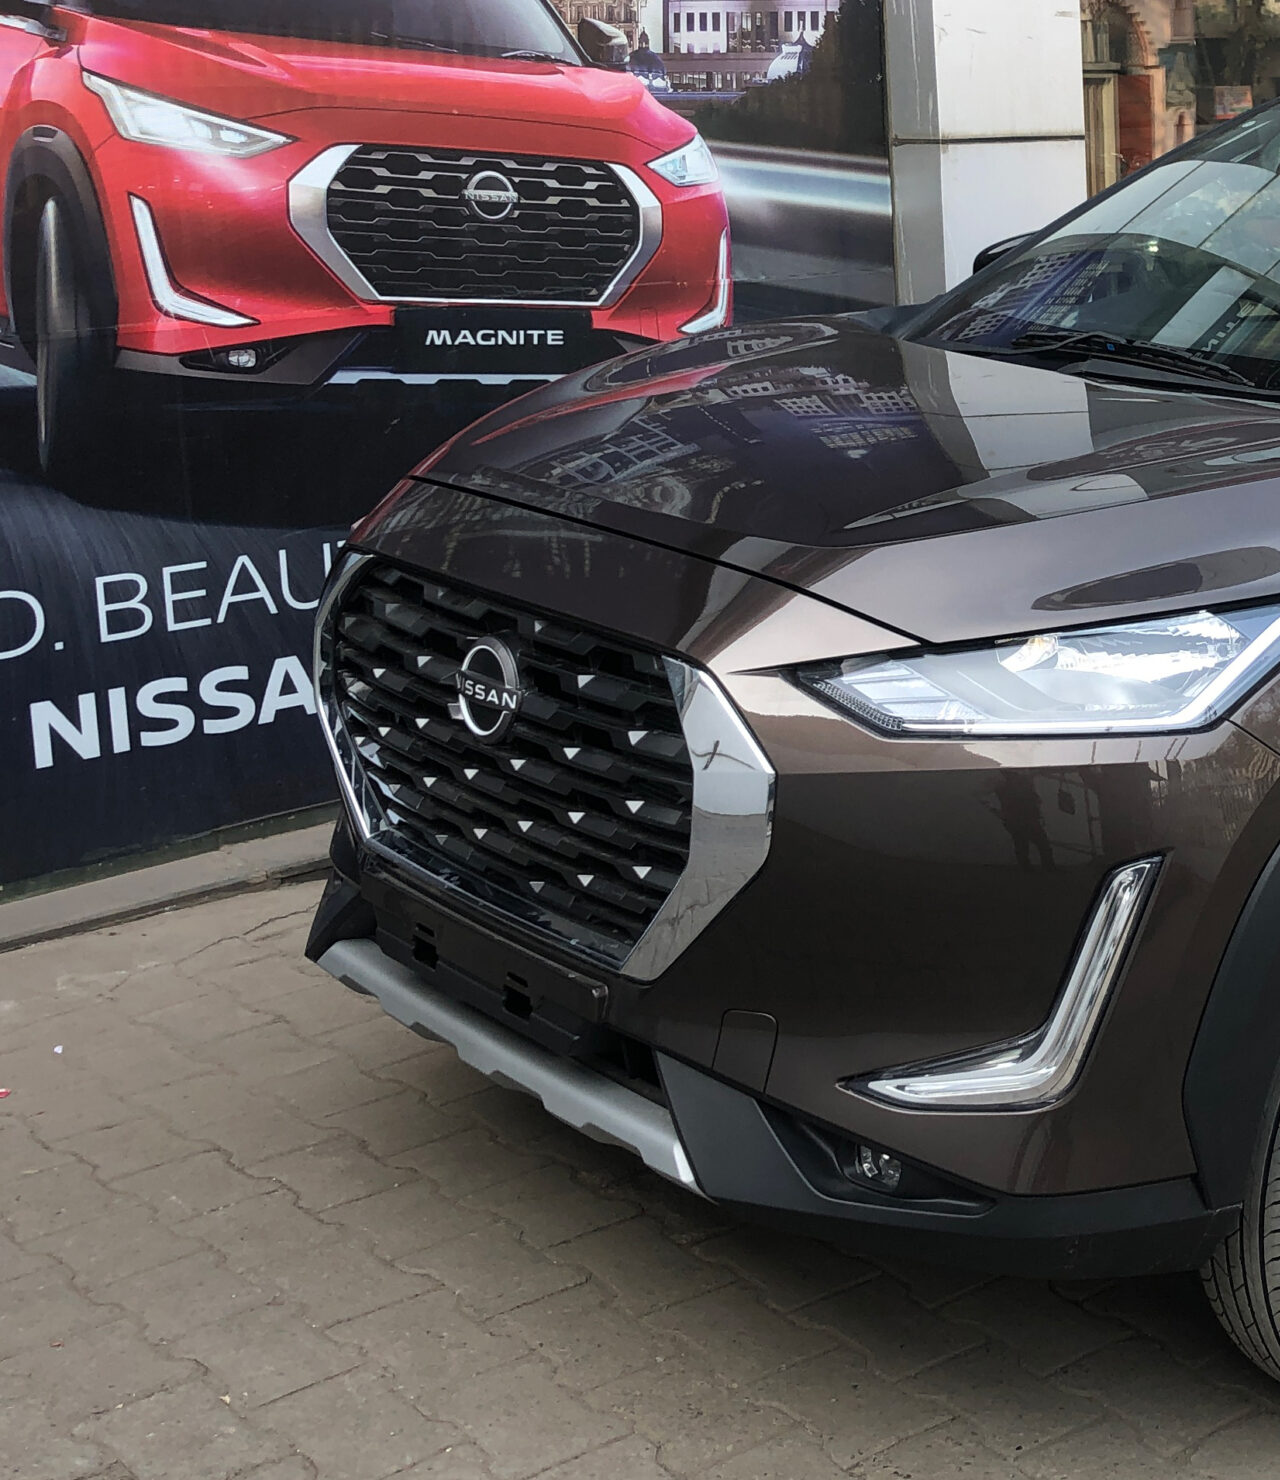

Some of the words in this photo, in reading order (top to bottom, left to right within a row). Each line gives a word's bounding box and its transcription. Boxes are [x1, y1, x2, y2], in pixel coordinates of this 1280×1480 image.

[464, 192, 519, 203] NISSAN
[425, 329, 565, 346] MAGNITE
[95, 541, 345, 643] BEAU
[455, 671, 518, 710] NISSAN
[29, 655, 318, 770] NISSA
